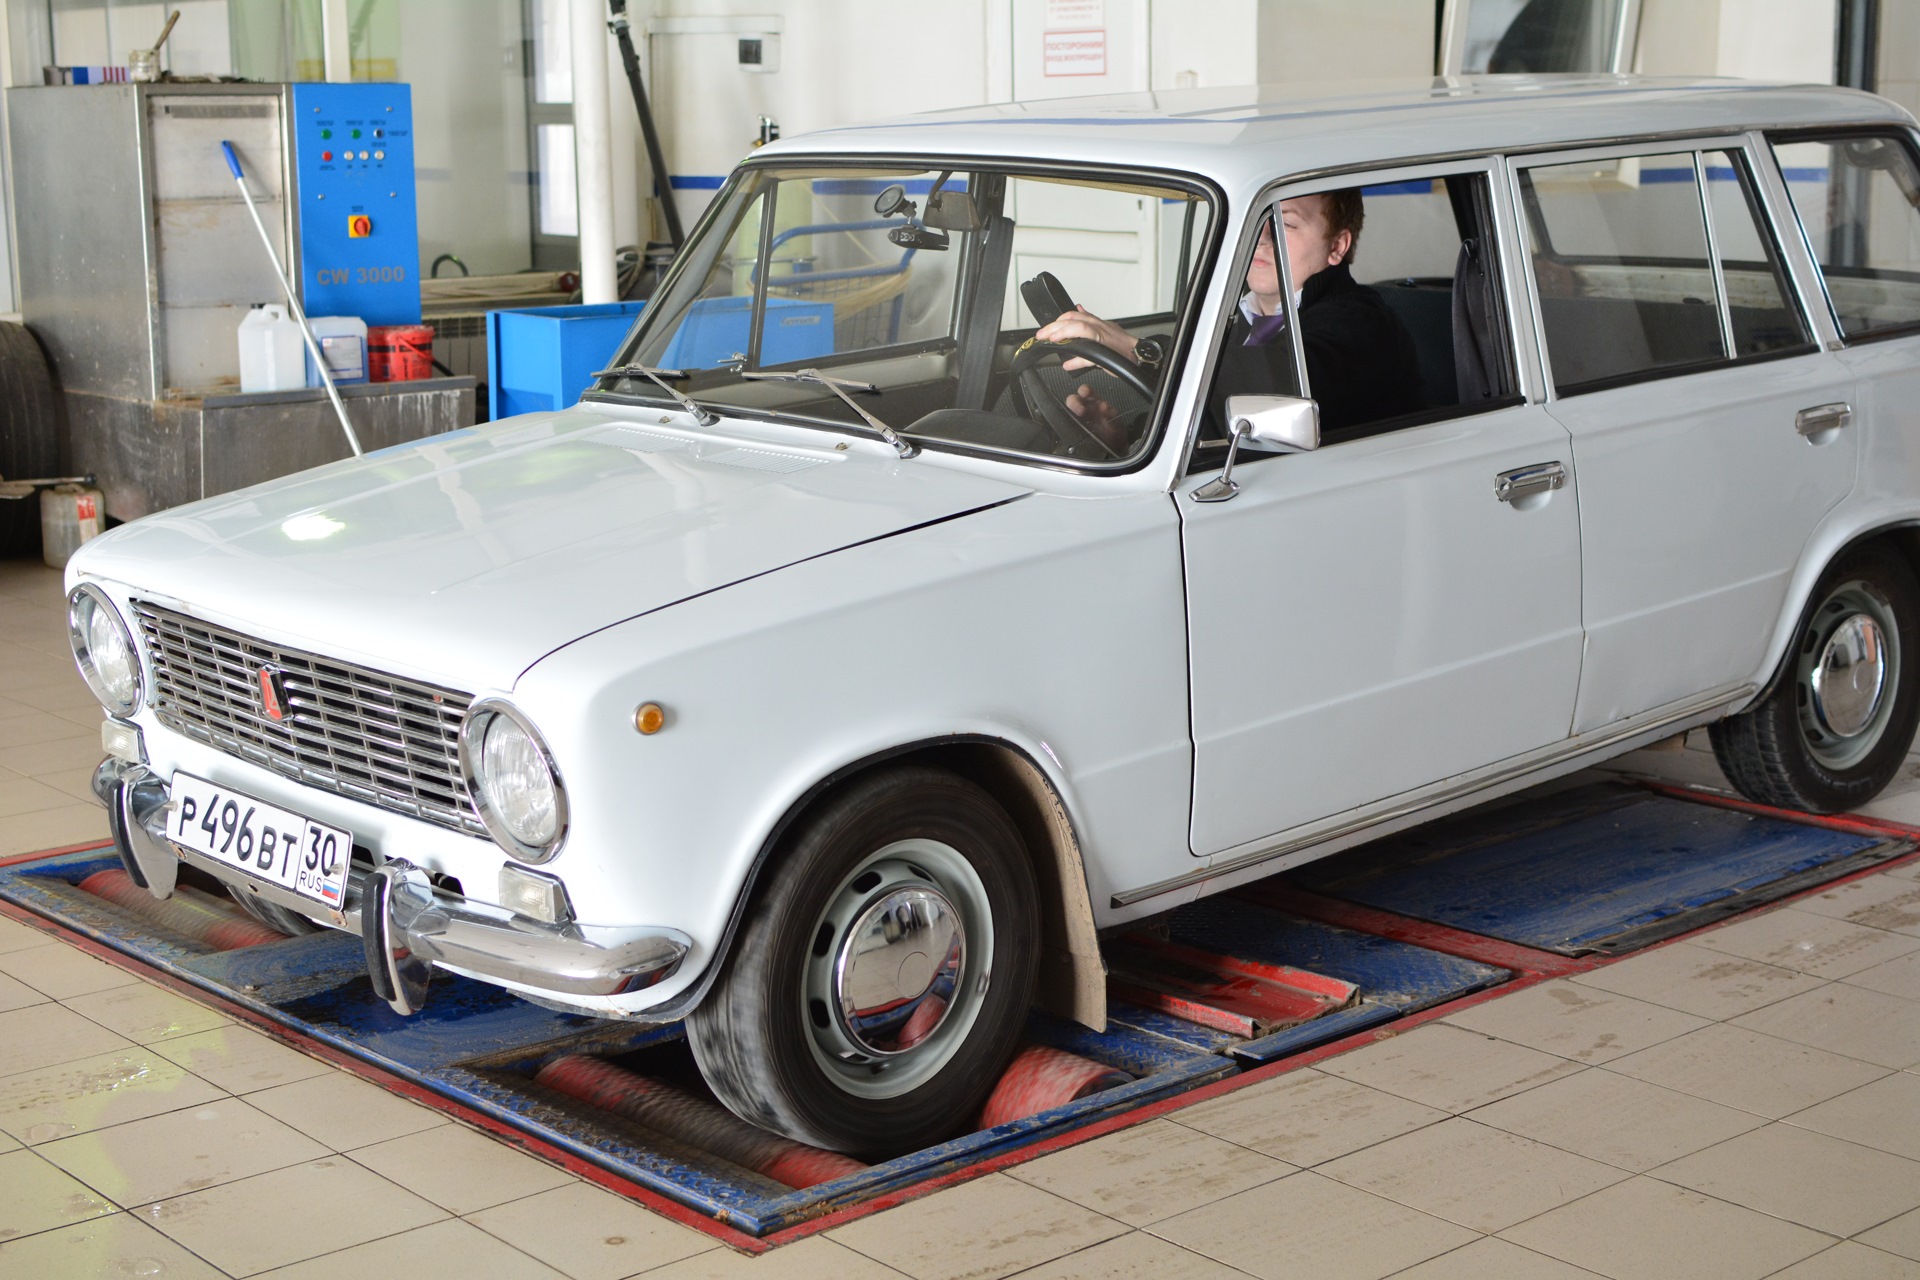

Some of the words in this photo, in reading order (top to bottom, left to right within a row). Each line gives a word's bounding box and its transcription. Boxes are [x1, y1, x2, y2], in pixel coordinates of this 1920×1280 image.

[317, 268, 350, 285] CW
[356, 266, 405, 284] 3000
[305, 826, 337, 877] 30
[300, 870, 323, 892] RUS
